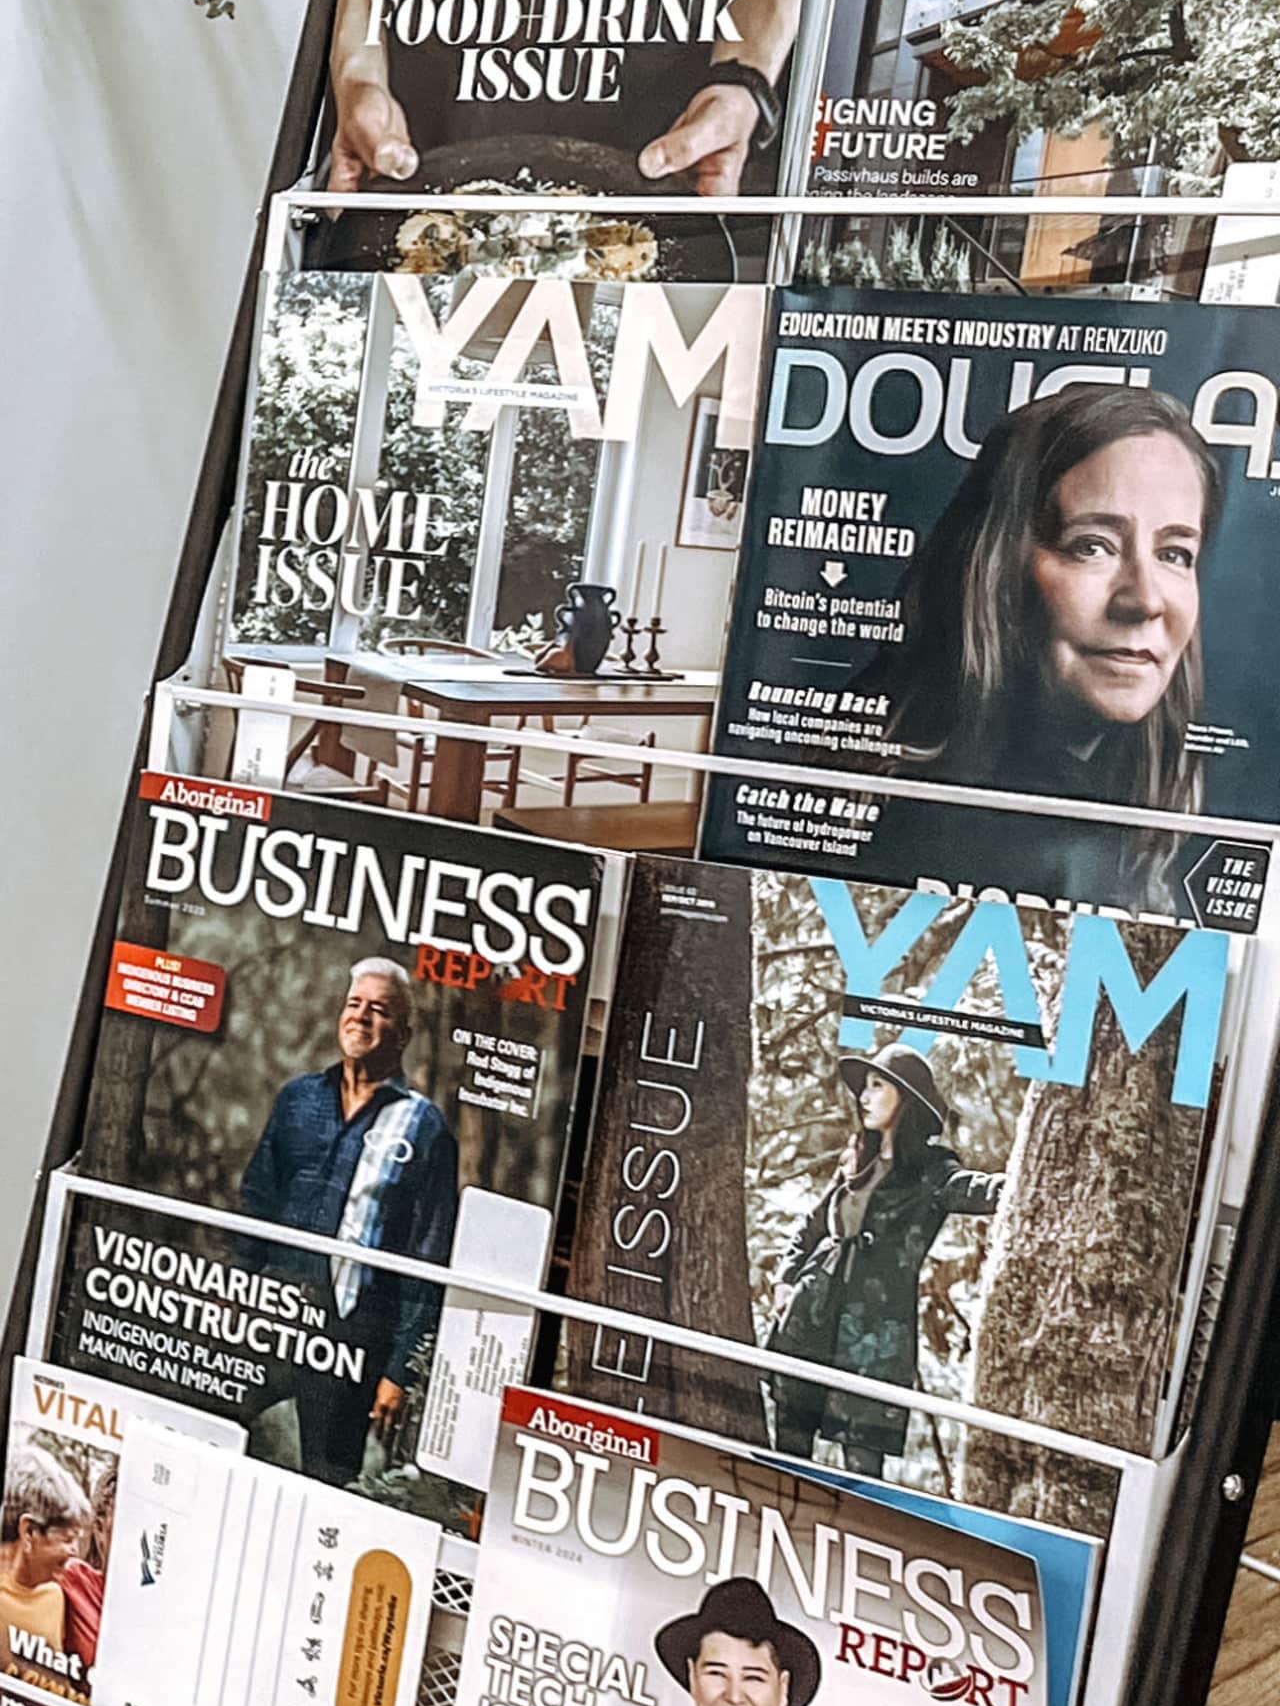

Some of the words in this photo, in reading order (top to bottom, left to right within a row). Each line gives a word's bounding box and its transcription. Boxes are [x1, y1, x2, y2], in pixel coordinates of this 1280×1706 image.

[454, 47, 624, 103] ISSUE
[823, 132, 948, 160] FUTURE
[814, 166, 898, 184] Passivhaus
[902, 169, 949, 186] builds
[951, 173, 978, 187] are
[779, 311, 878, 340] EDUCATION
[882, 317, 950, 345] MEETS
[953, 320, 1055, 350] INDUSTRY
[1057, 326, 1081, 350] AT
[1084, 327, 1168, 356] RENZUKO
[380, 274, 773, 450] YAM
[288, 446, 336, 481] the
[259, 480, 451, 556] HOME
[801, 487, 888, 522] MONEY
[767, 517, 916, 557] REIMAGINED
[253, 544, 427, 622] ISSUE
[765, 588, 827, 612] Bitcoin's
[830, 597, 900, 620] potential
[757, 610, 771, 628] to
[774, 612, 828, 638] change
[830, 618, 856, 637] the
[859, 624, 904, 642] world
[748, 681, 837, 713] Bouncing
[840, 692, 890, 716] Back
[728, 722, 781, 743] navigating
[784, 729, 838, 751] oncoming
[841, 736, 901, 757] challenges
[772, 710, 799, 727] local
[801, 716, 861, 734] companies
[864, 724, 883, 736] are
[160, 780, 266, 821] Aboriginal
[736, 785, 789, 809] Catch
[793, 792, 827, 814] the
[830, 797, 880, 822] Wave
[736, 810, 755, 825] The
[757, 813, 790, 831] future
[807, 820, 873, 842] hydropower
[764, 831, 820, 851] Vancouver
[823, 840, 858, 857] Island
[1223, 858, 1255, 878] THE
[144, 805, 591, 976] BUSINESS
[1206, 877, 1264, 900] VISION
[1206, 899, 1257, 921] ISSUE
[809, 877, 1229, 1108] YAM
[452, 1028, 472, 1045] ON
[474, 1032, 496, 1051] THE
[916, 1012, 969, 1030] LIFESTYLE
[970, 1020, 1024, 1039] MAGAZINE
[608, 1012, 705, 1283] ISSUE
[94, 1226, 301, 1319] VISIONARIES
[86, 1267, 365, 1383] CONSTRUCTION
[83, 1309, 191, 1361] INDIGENOUS
[193, 1345, 266, 1386] PLAYERS
[79, 1333, 148, 1371] MAKING
[150, 1358, 178, 1383] AN
[181, 1367, 248, 1403] IMPACT
[33, 1383, 124, 1441] VITAL
[528, 1407, 652, 1463] Aboriginal
[511, 1433, 1037, 1685] BUSINESS
[9, 1624, 83, 1681] What
